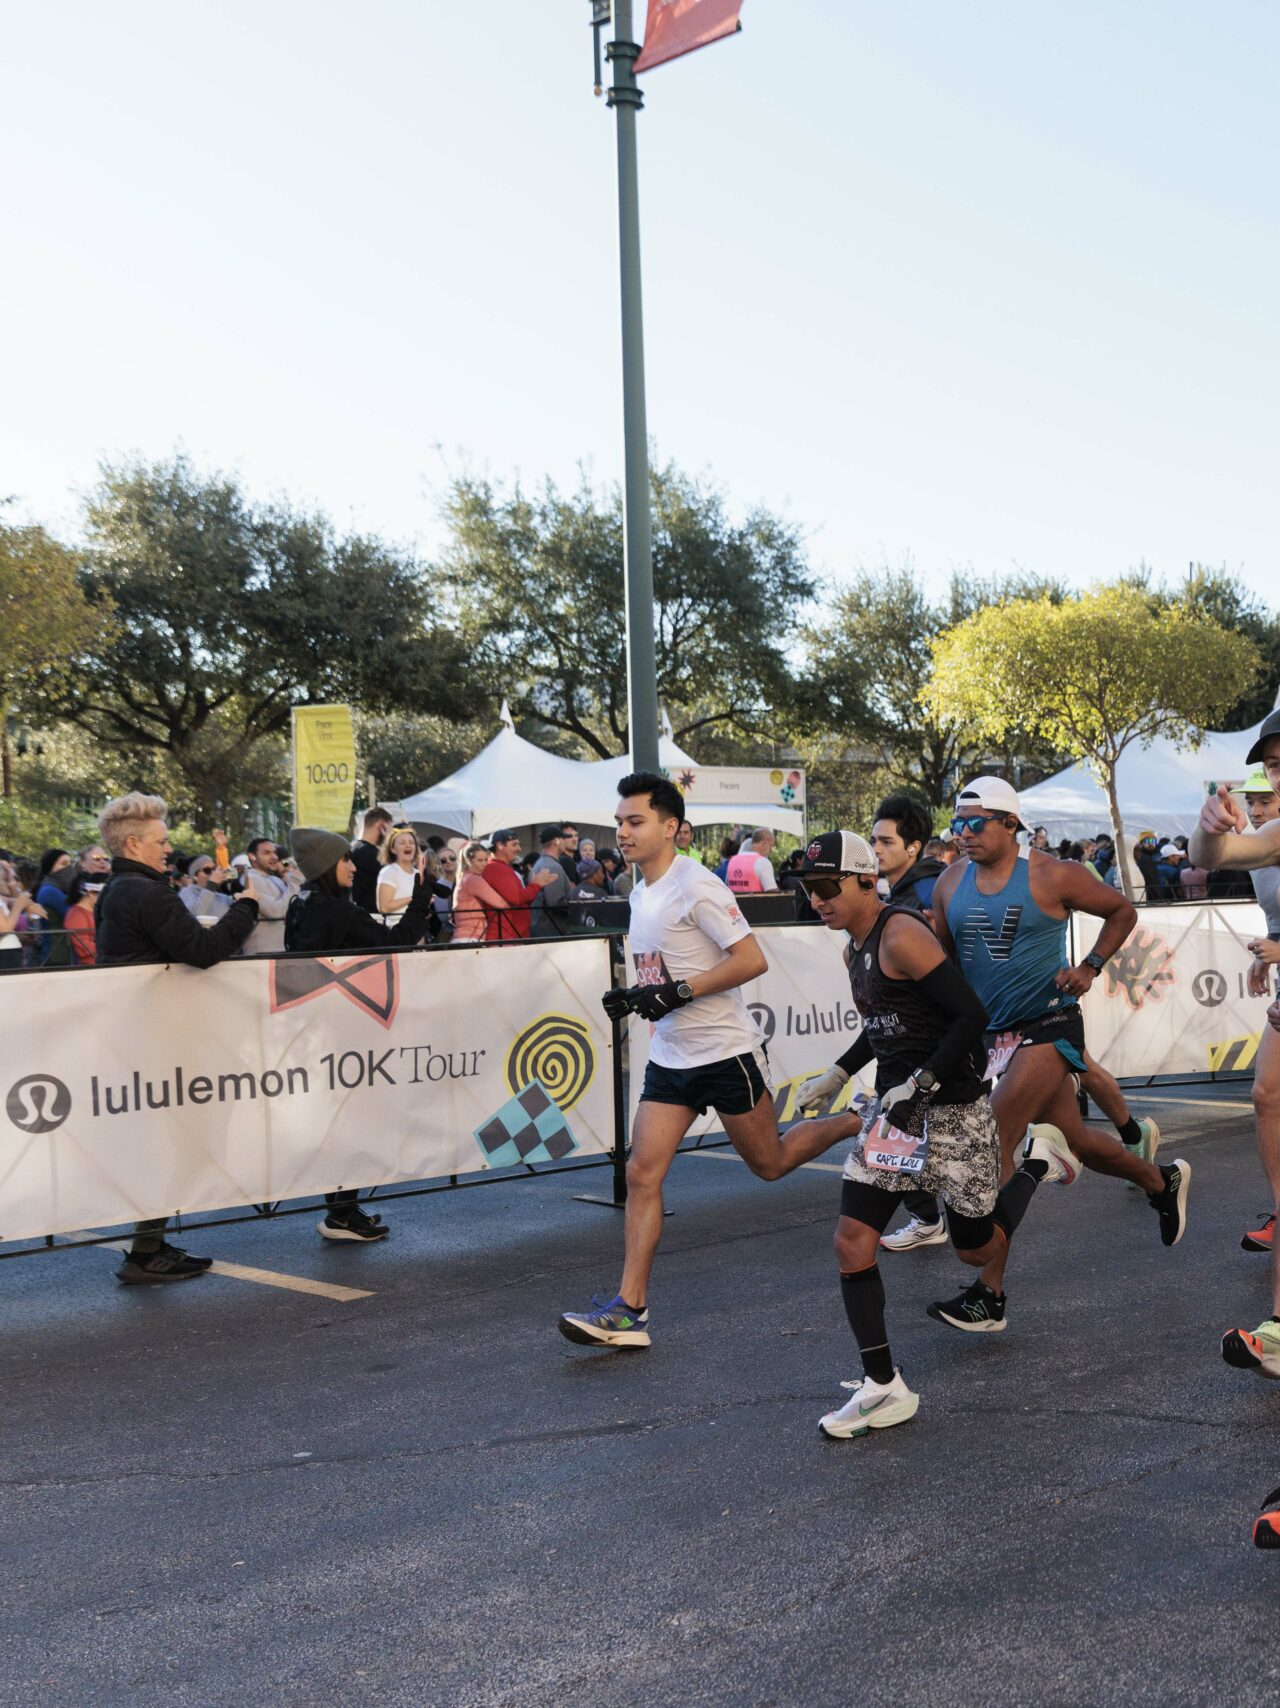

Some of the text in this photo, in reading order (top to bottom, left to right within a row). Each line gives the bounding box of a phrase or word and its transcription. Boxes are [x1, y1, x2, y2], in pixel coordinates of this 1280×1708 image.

[305, 763, 349, 784] 10:00
[719, 781, 740, 790] Pacers
[636, 966, 662, 987] 933
[91, 1044, 486, 1117] lululemon 10K Tour
[877, 1153, 919, 1169] CAPT. LOU
